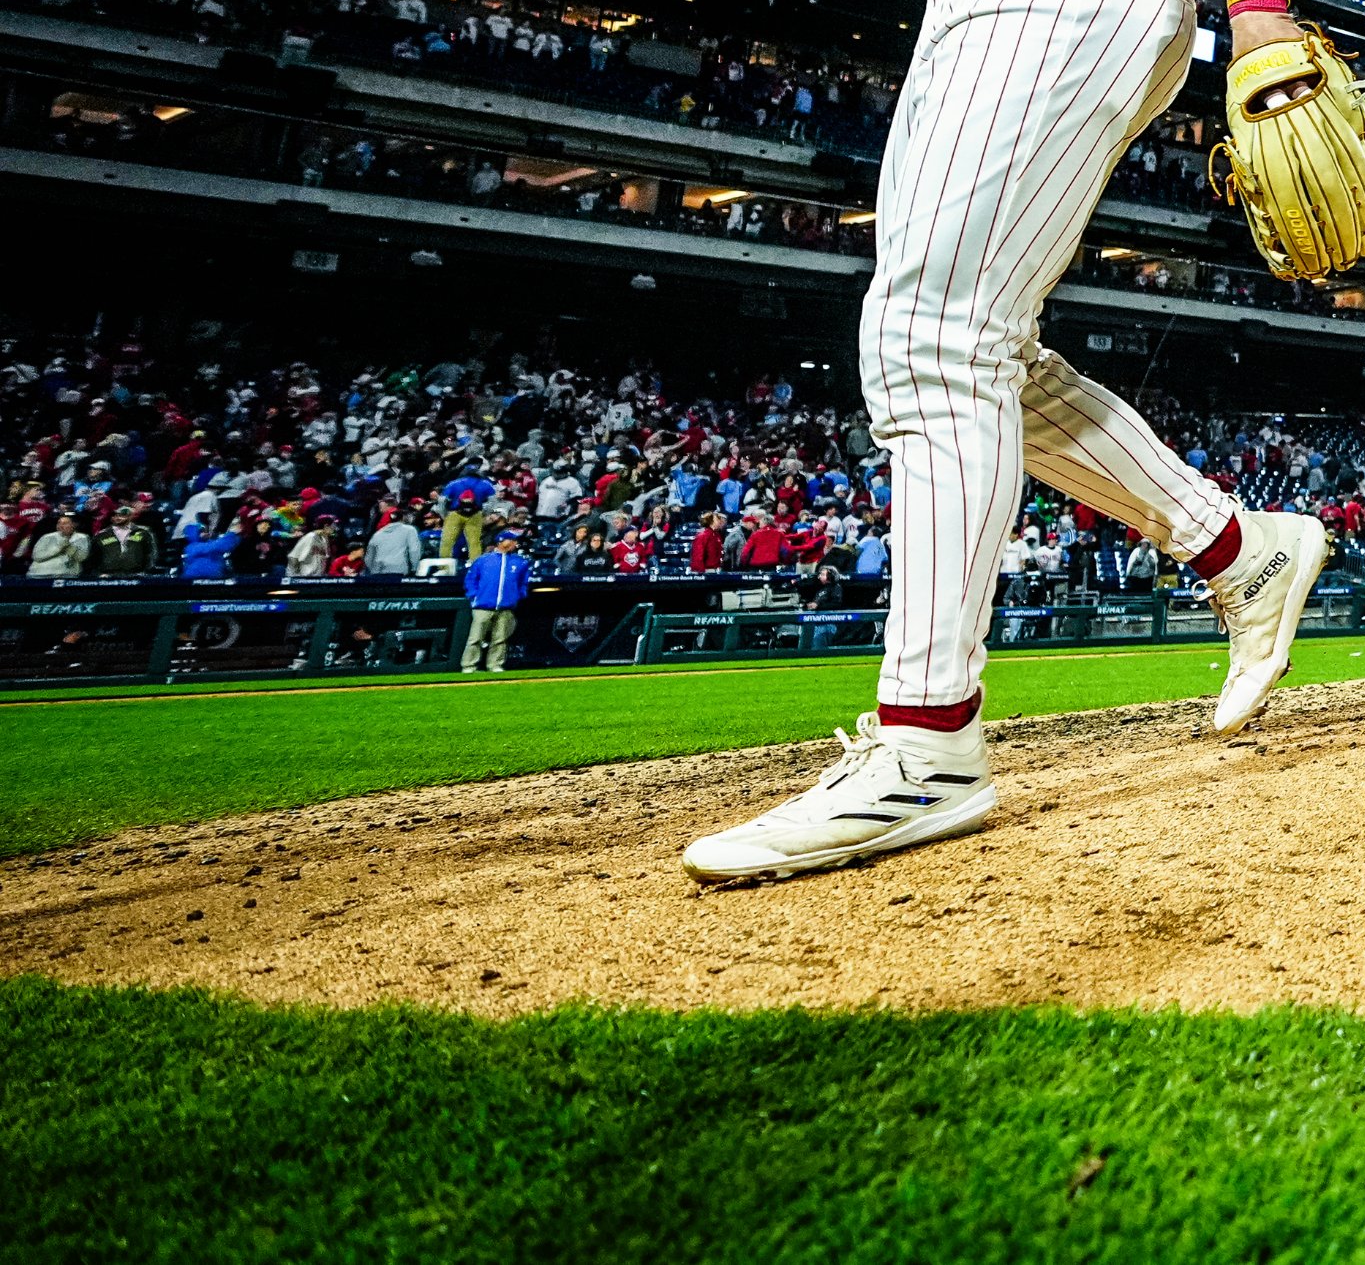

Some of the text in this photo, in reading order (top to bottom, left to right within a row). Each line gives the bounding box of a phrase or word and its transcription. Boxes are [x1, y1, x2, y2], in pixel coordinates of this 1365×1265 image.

[1243, 551, 1287, 601] ADIZERO
[30, 600, 420, 615] RE/MAX smartwater RE/MAX
[1004, 606, 1126, 617] smartwater RE/MAX
[694, 614, 844, 626] RE/MAX smartwater
